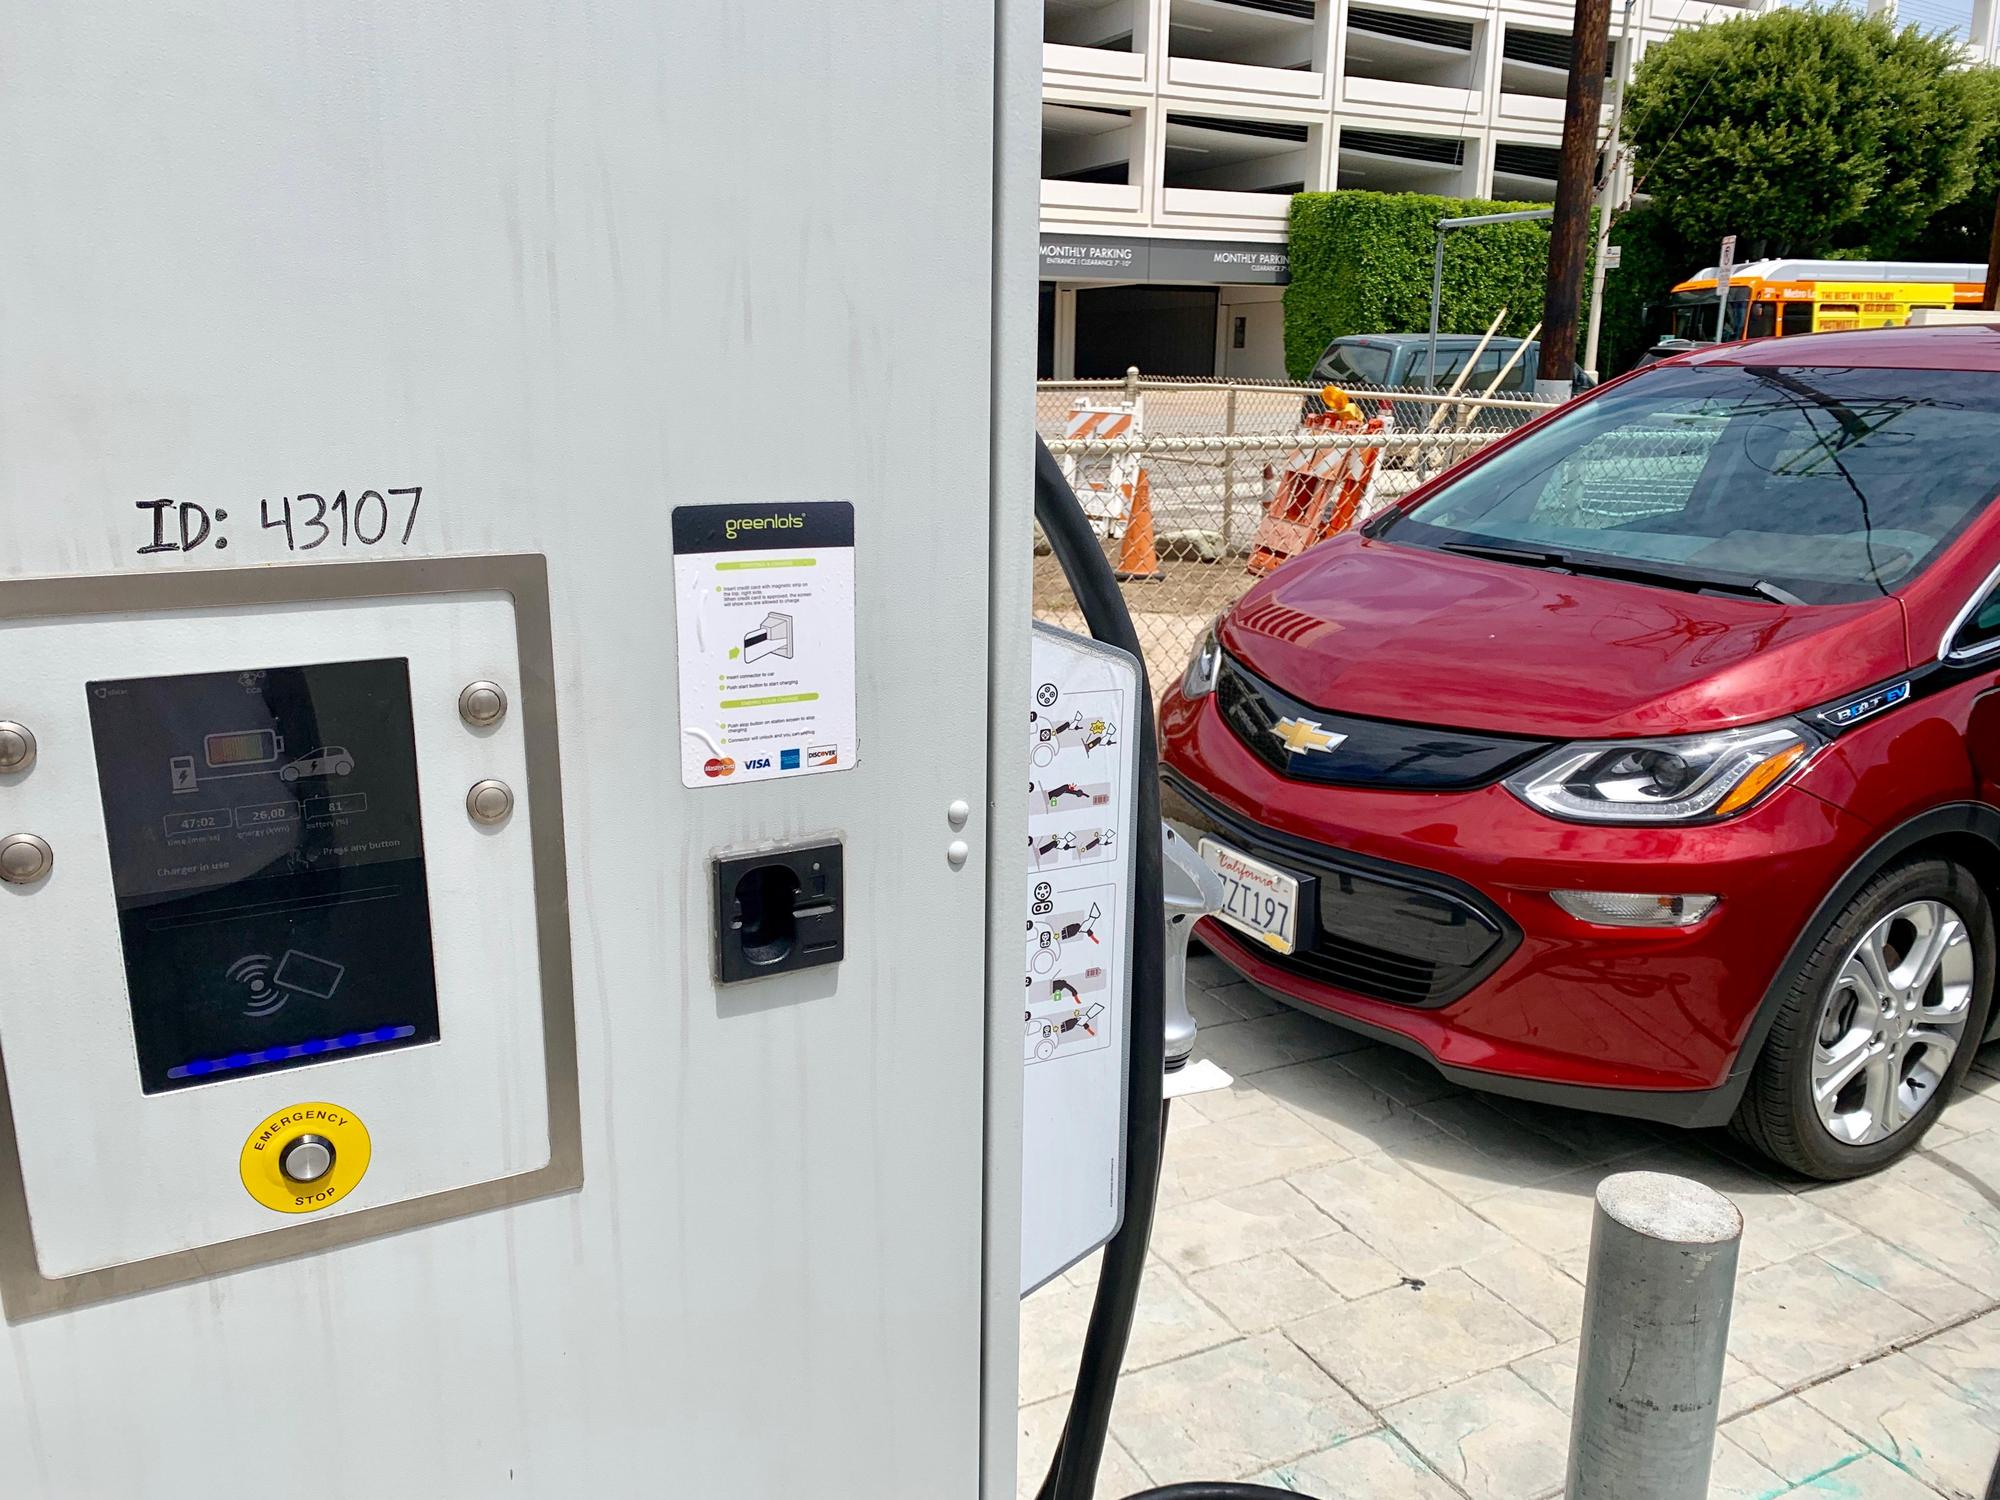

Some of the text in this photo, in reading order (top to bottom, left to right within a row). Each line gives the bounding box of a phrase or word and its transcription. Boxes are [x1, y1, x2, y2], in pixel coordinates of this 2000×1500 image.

[1039, 245, 1132, 259] MONTHLY PARKING
[1213, 252, 1290, 265] MONTHLY PARKIN
[1046, 257, 1076, 265] ENTRANCE
[1251, 264, 1280, 272] CLEARANCE
[1784, 288, 1806, 299] Metro
[136, 487, 422, 554] ID: 43107
[725, 513, 804, 540] greenlots
[1837, 685, 1906, 721] BOLT EV
[744, 758, 771, 770] VISA
[808, 749, 836, 759] DISCOVER
[328, 802, 343, 812] 81
[252, 808, 286, 822] 26,00
[181, 817, 216, 829] 47:02
[323, 840, 401, 856] Press any button
[156, 862, 230, 877] Charger in use
[1218, 851, 1279, 893] California
[1218, 873, 1289, 937] ZT197
[254, 1110, 348, 1151] EMERGENCY
[295, 1187, 335, 1206] STOP
